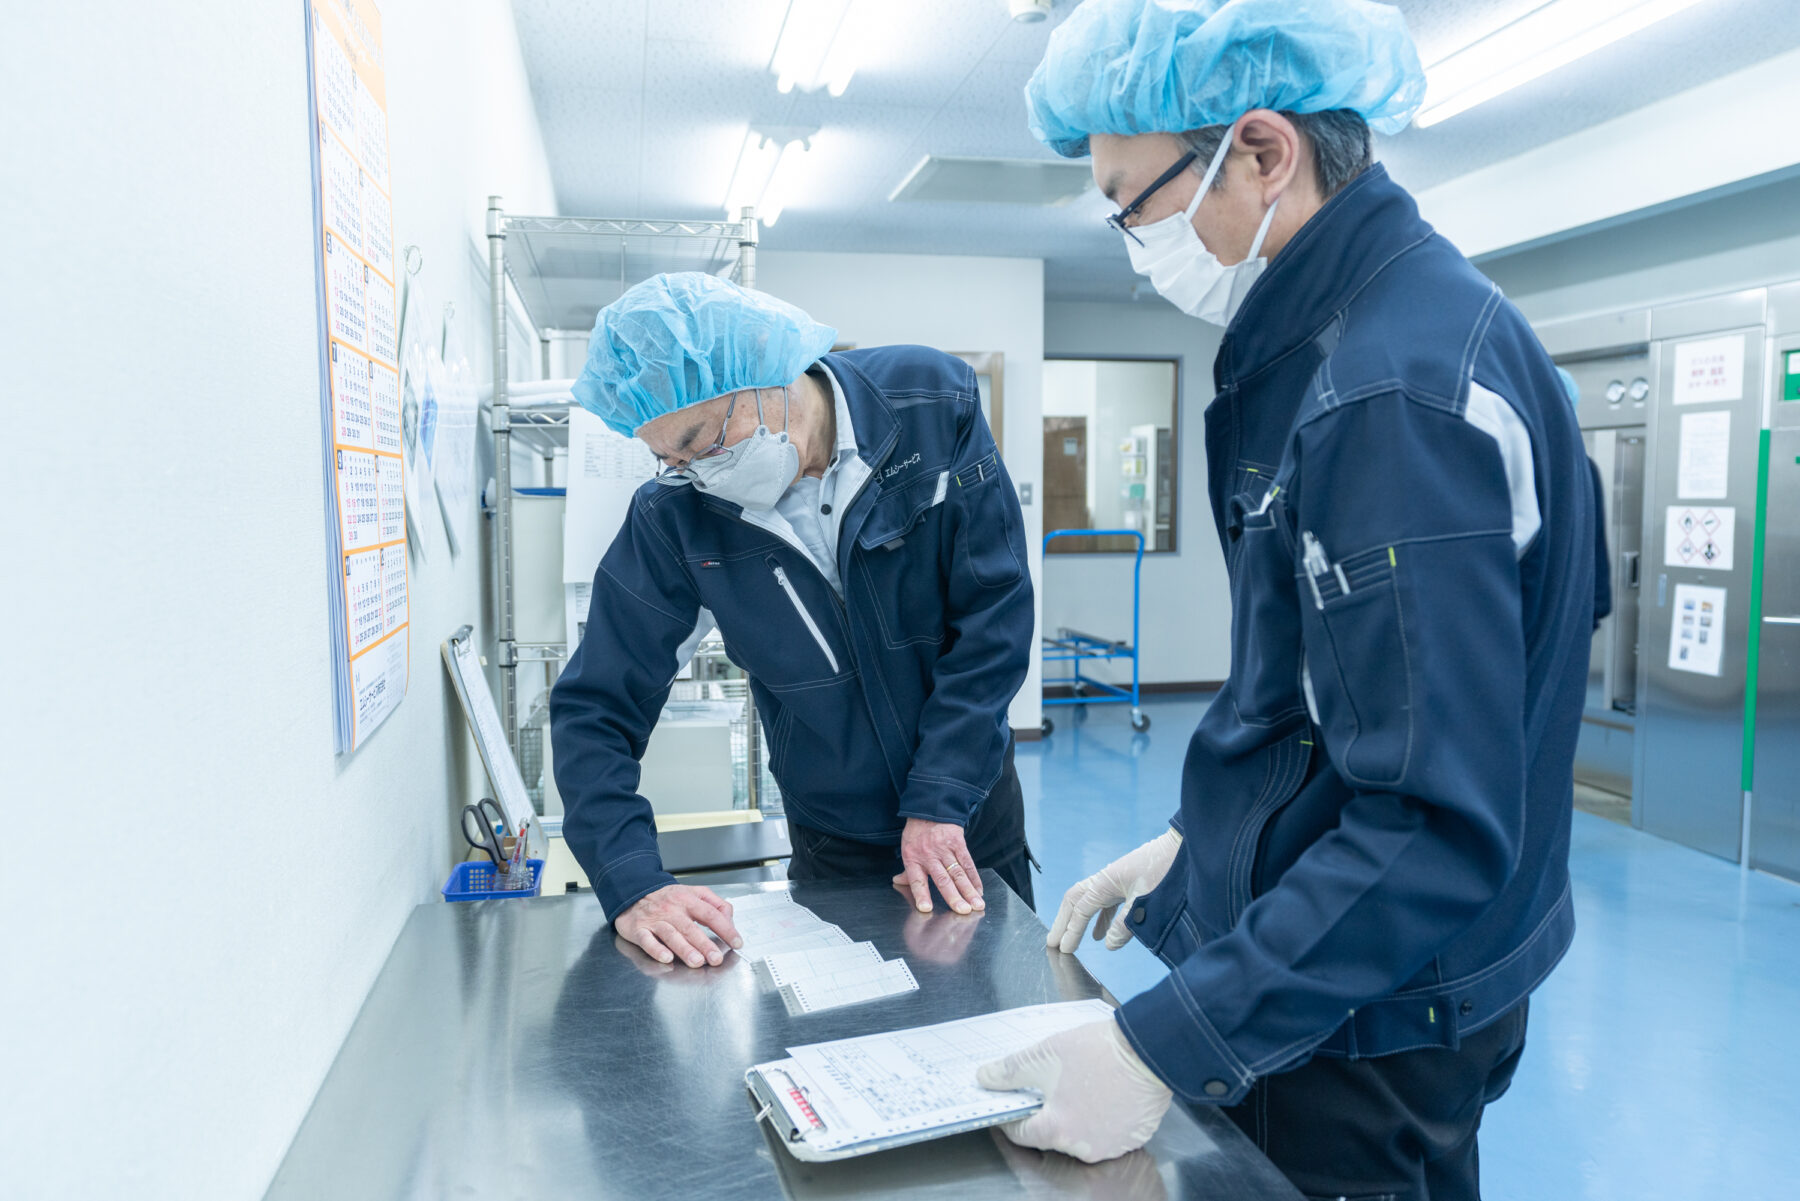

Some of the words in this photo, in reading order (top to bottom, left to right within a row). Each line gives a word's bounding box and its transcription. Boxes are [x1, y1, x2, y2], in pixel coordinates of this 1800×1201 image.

[885, 453, 921, 478] エムシーサービス
